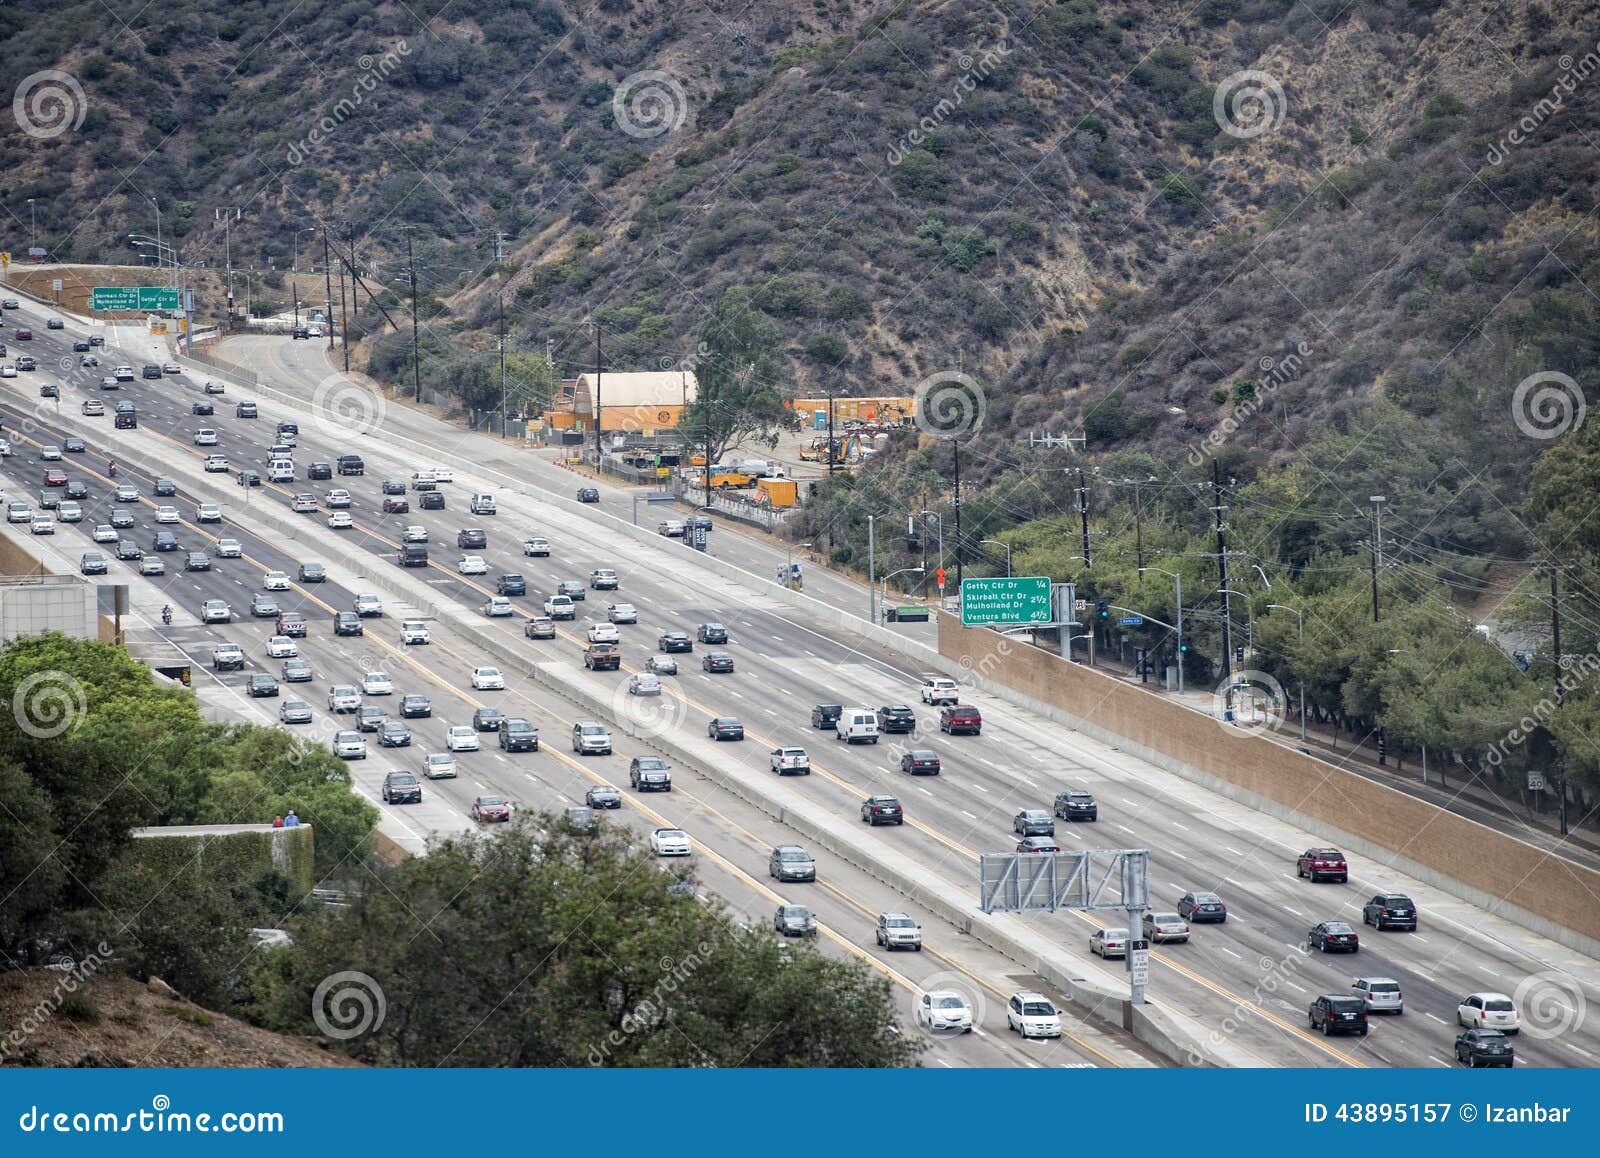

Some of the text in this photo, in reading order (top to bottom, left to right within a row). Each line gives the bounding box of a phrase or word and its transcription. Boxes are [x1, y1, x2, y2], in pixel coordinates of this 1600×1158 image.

[966, 582, 988, 590] Getty
[966, 601, 1011, 610] Mulholland
[1001, 611, 1020, 619] Blvd
[1530, 780, 1543, 788] 40
